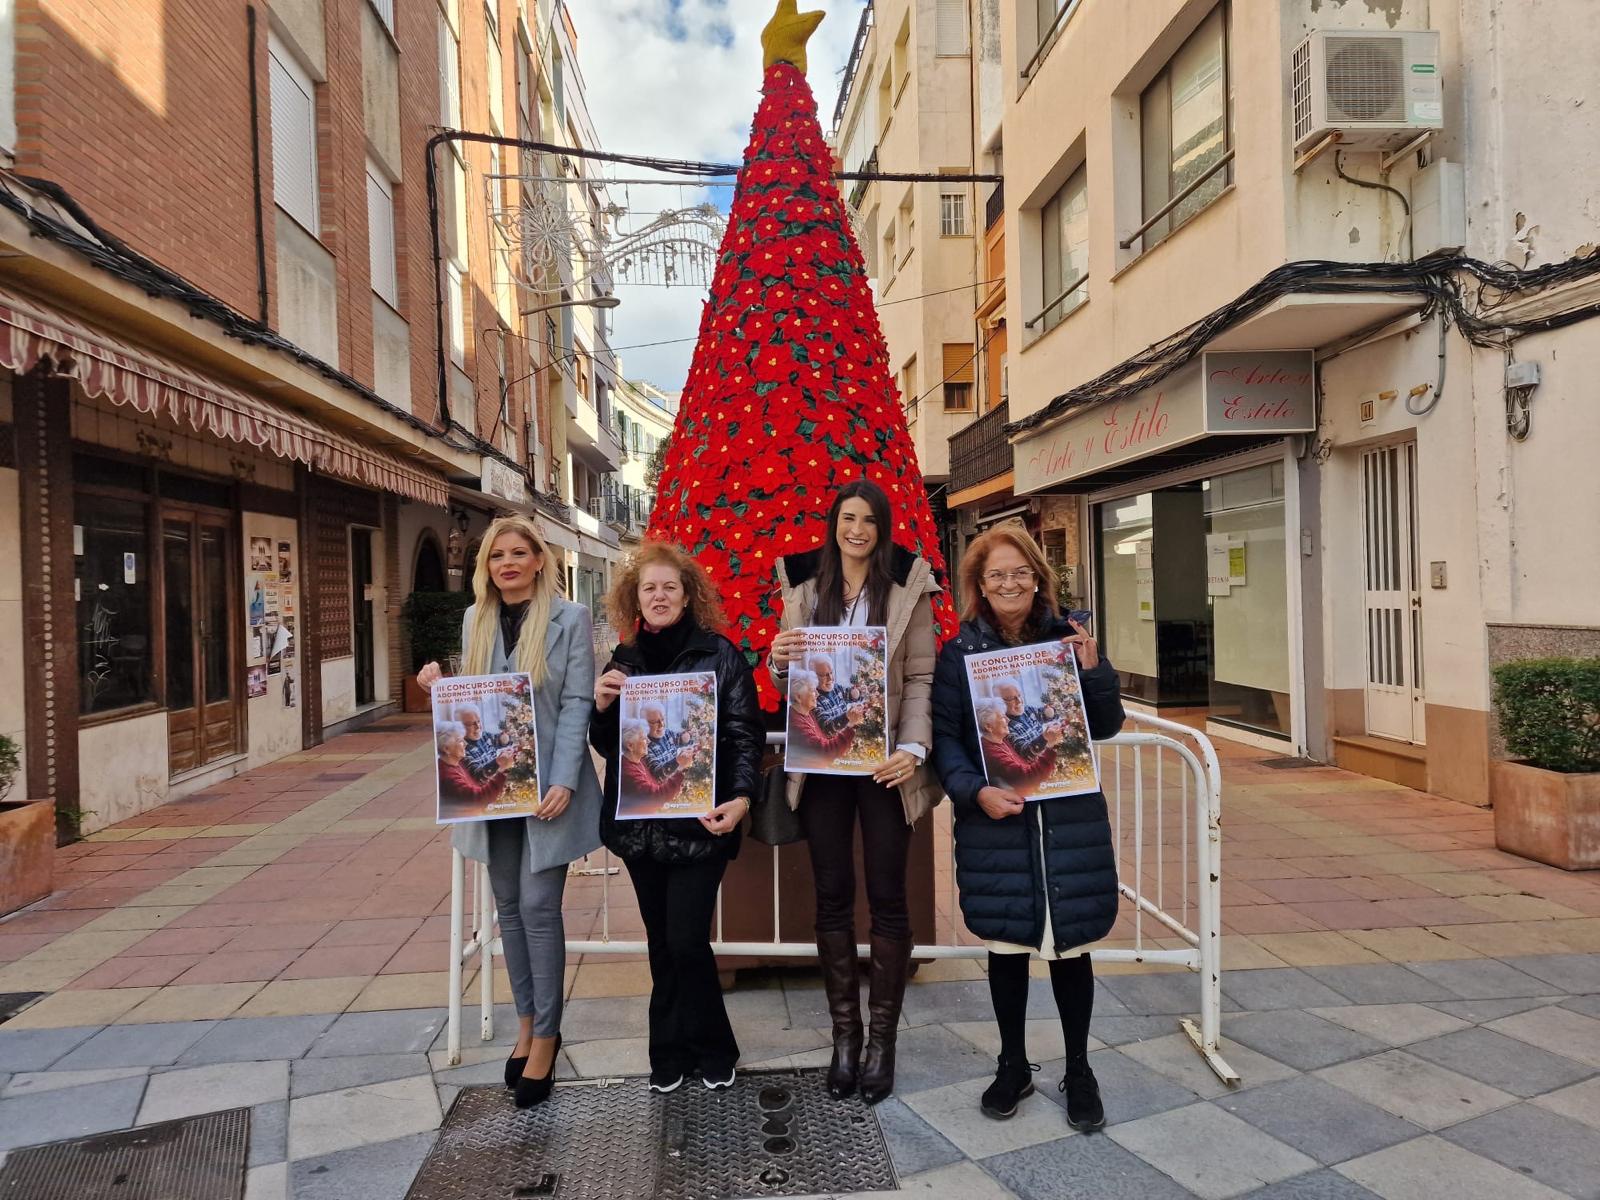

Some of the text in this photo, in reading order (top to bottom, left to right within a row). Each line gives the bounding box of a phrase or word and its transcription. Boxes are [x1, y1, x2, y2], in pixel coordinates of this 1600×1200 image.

[1222, 395, 1297, 421] Estilo
[1103, 391, 1169, 454] Estilo
[971, 650, 1048, 669] III CONCURSO DE
[972, 664, 1009, 675] ADORNOS
[446, 681, 495, 691] CONCURSO
[496, 680, 509, 688] DE
[635, 680, 681, 690] CONCURSO
